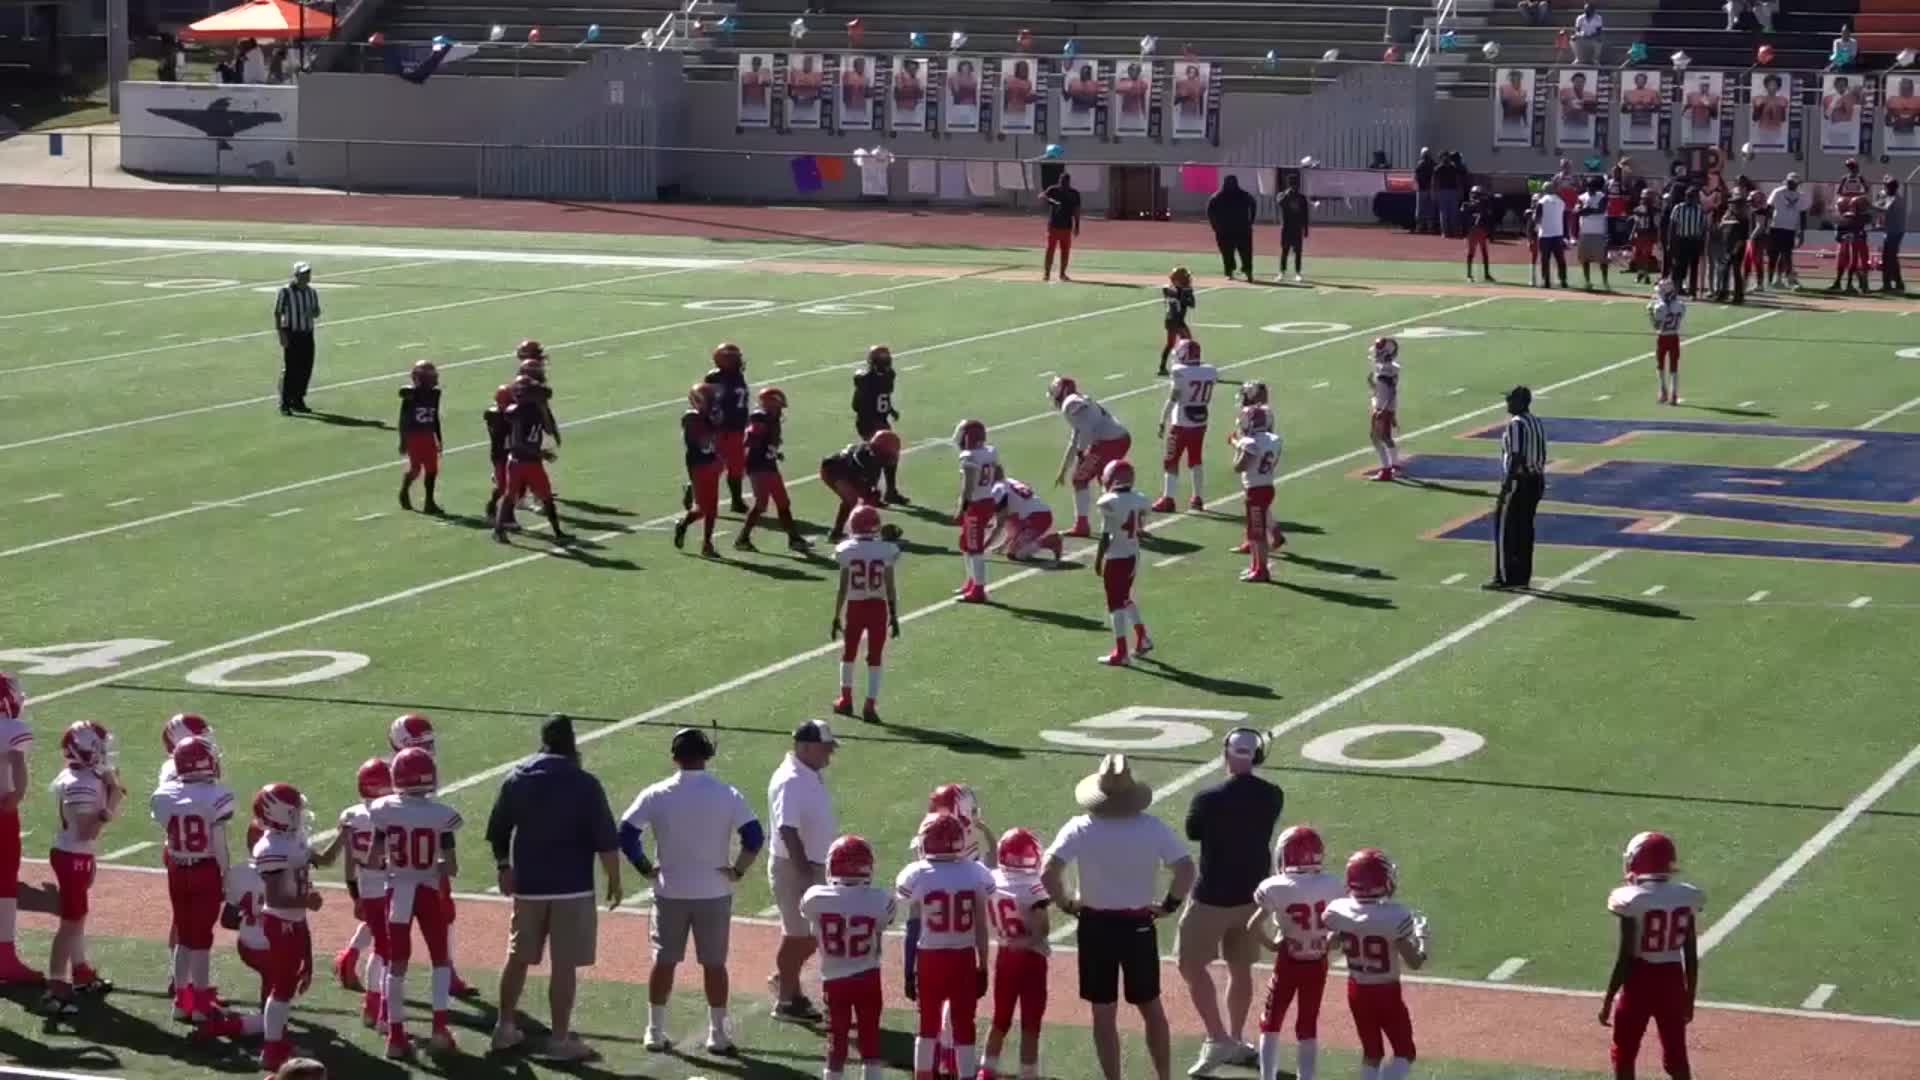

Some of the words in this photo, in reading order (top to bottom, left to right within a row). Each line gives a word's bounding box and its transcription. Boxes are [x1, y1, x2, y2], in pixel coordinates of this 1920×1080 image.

[1187, 380, 1213, 404] 70
[850, 559, 884, 591] 26
[1039, 705, 1485, 767] 50
[387, 826, 435, 870] 30
[819, 912, 875, 958] 82
